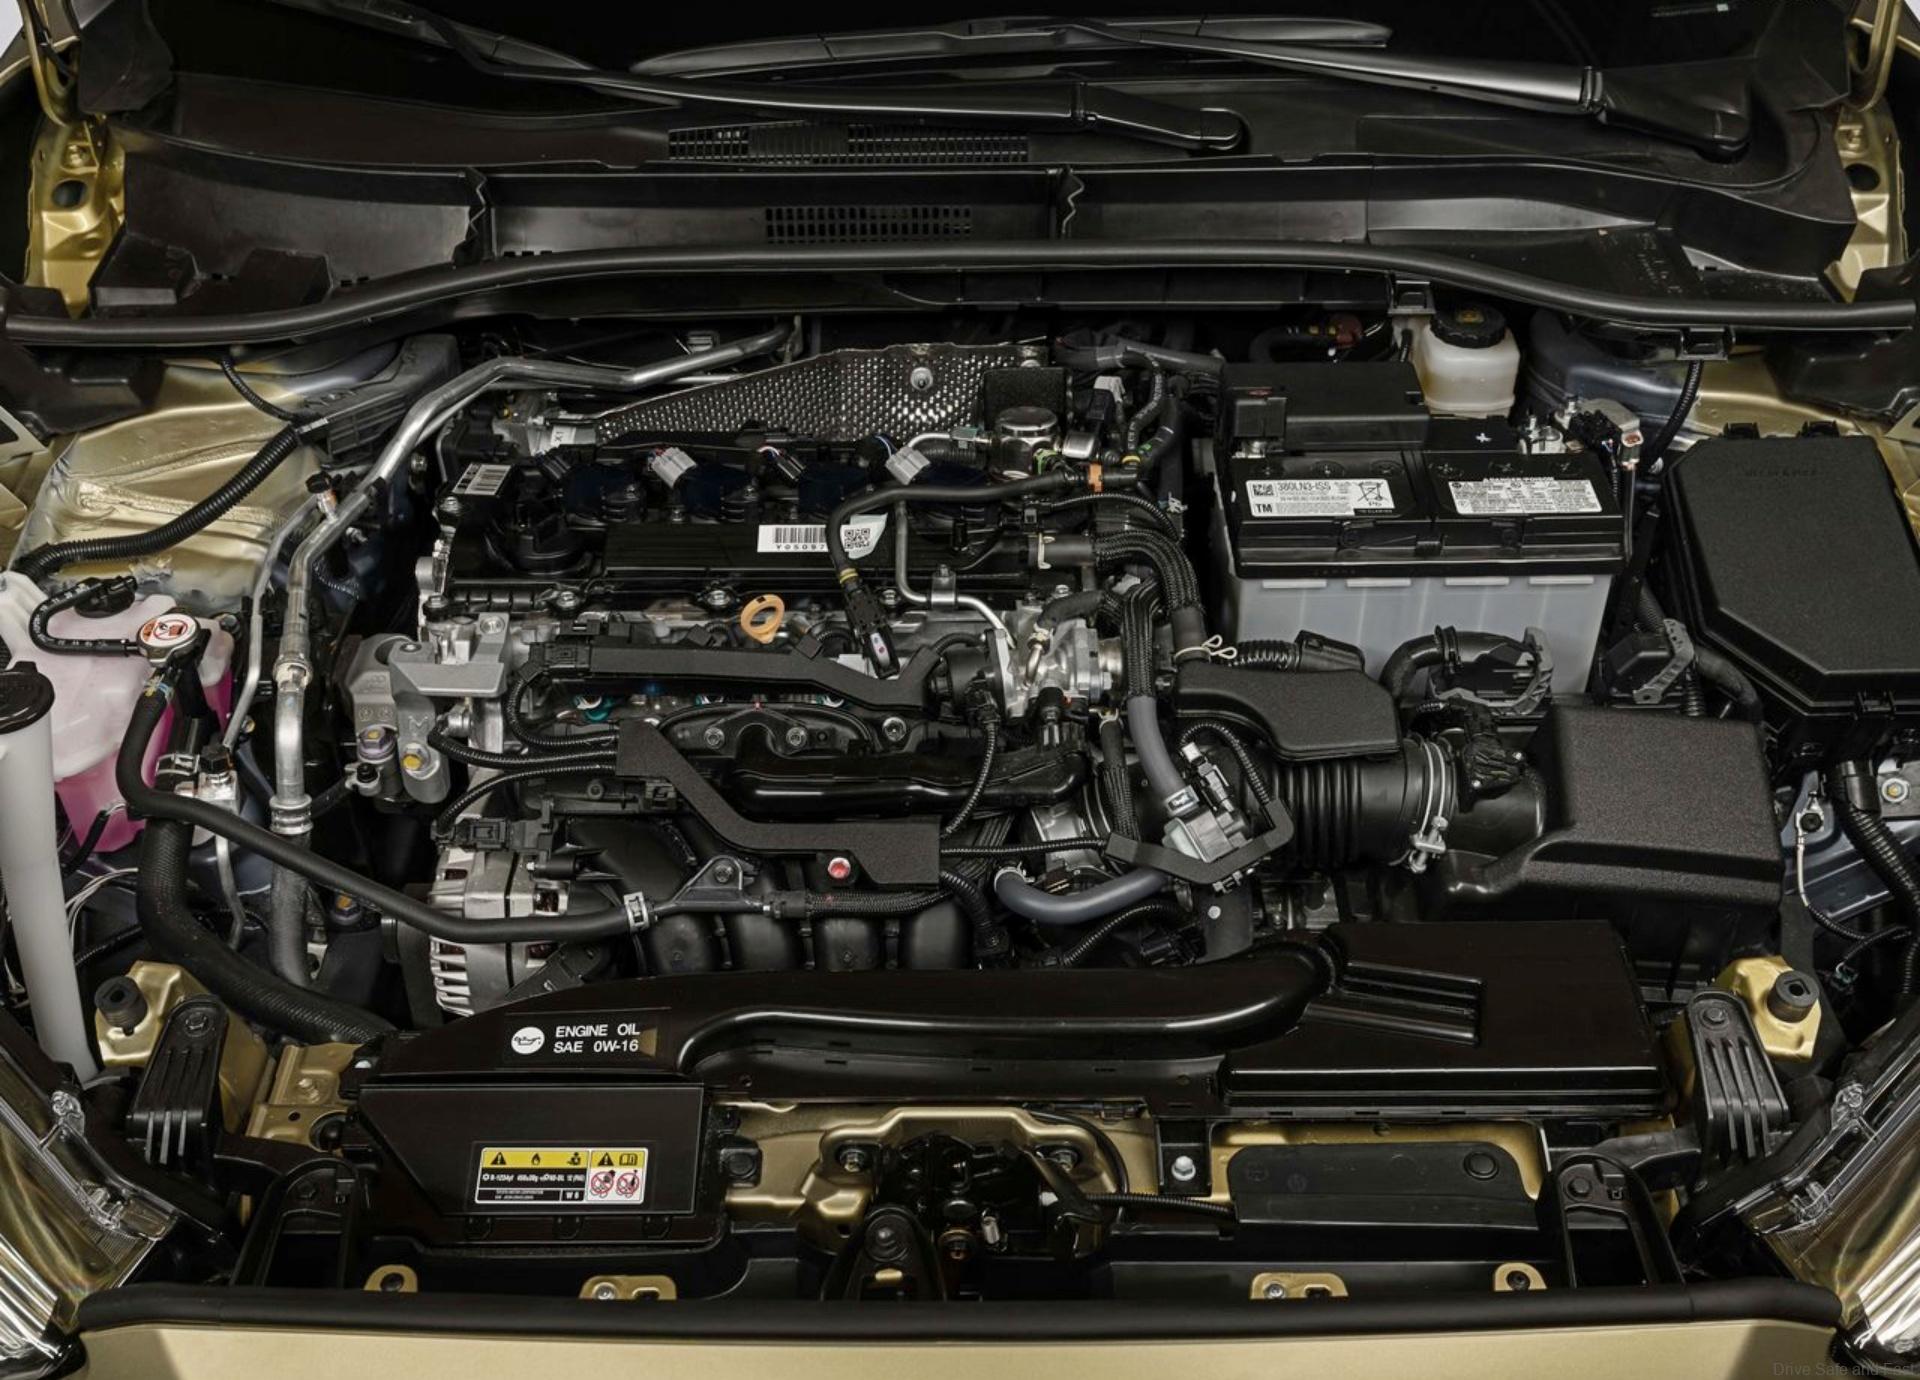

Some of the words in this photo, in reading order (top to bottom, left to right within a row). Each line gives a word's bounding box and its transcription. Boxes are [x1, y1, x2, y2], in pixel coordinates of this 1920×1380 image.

[1255, 503, 1273, 513] TM
[555, 1024, 608, 1038] ENGINE
[617, 1023, 641, 1036] OIL
[553, 1041, 584, 1054] SAE
[593, 1040, 639, 1053] 0W-16
